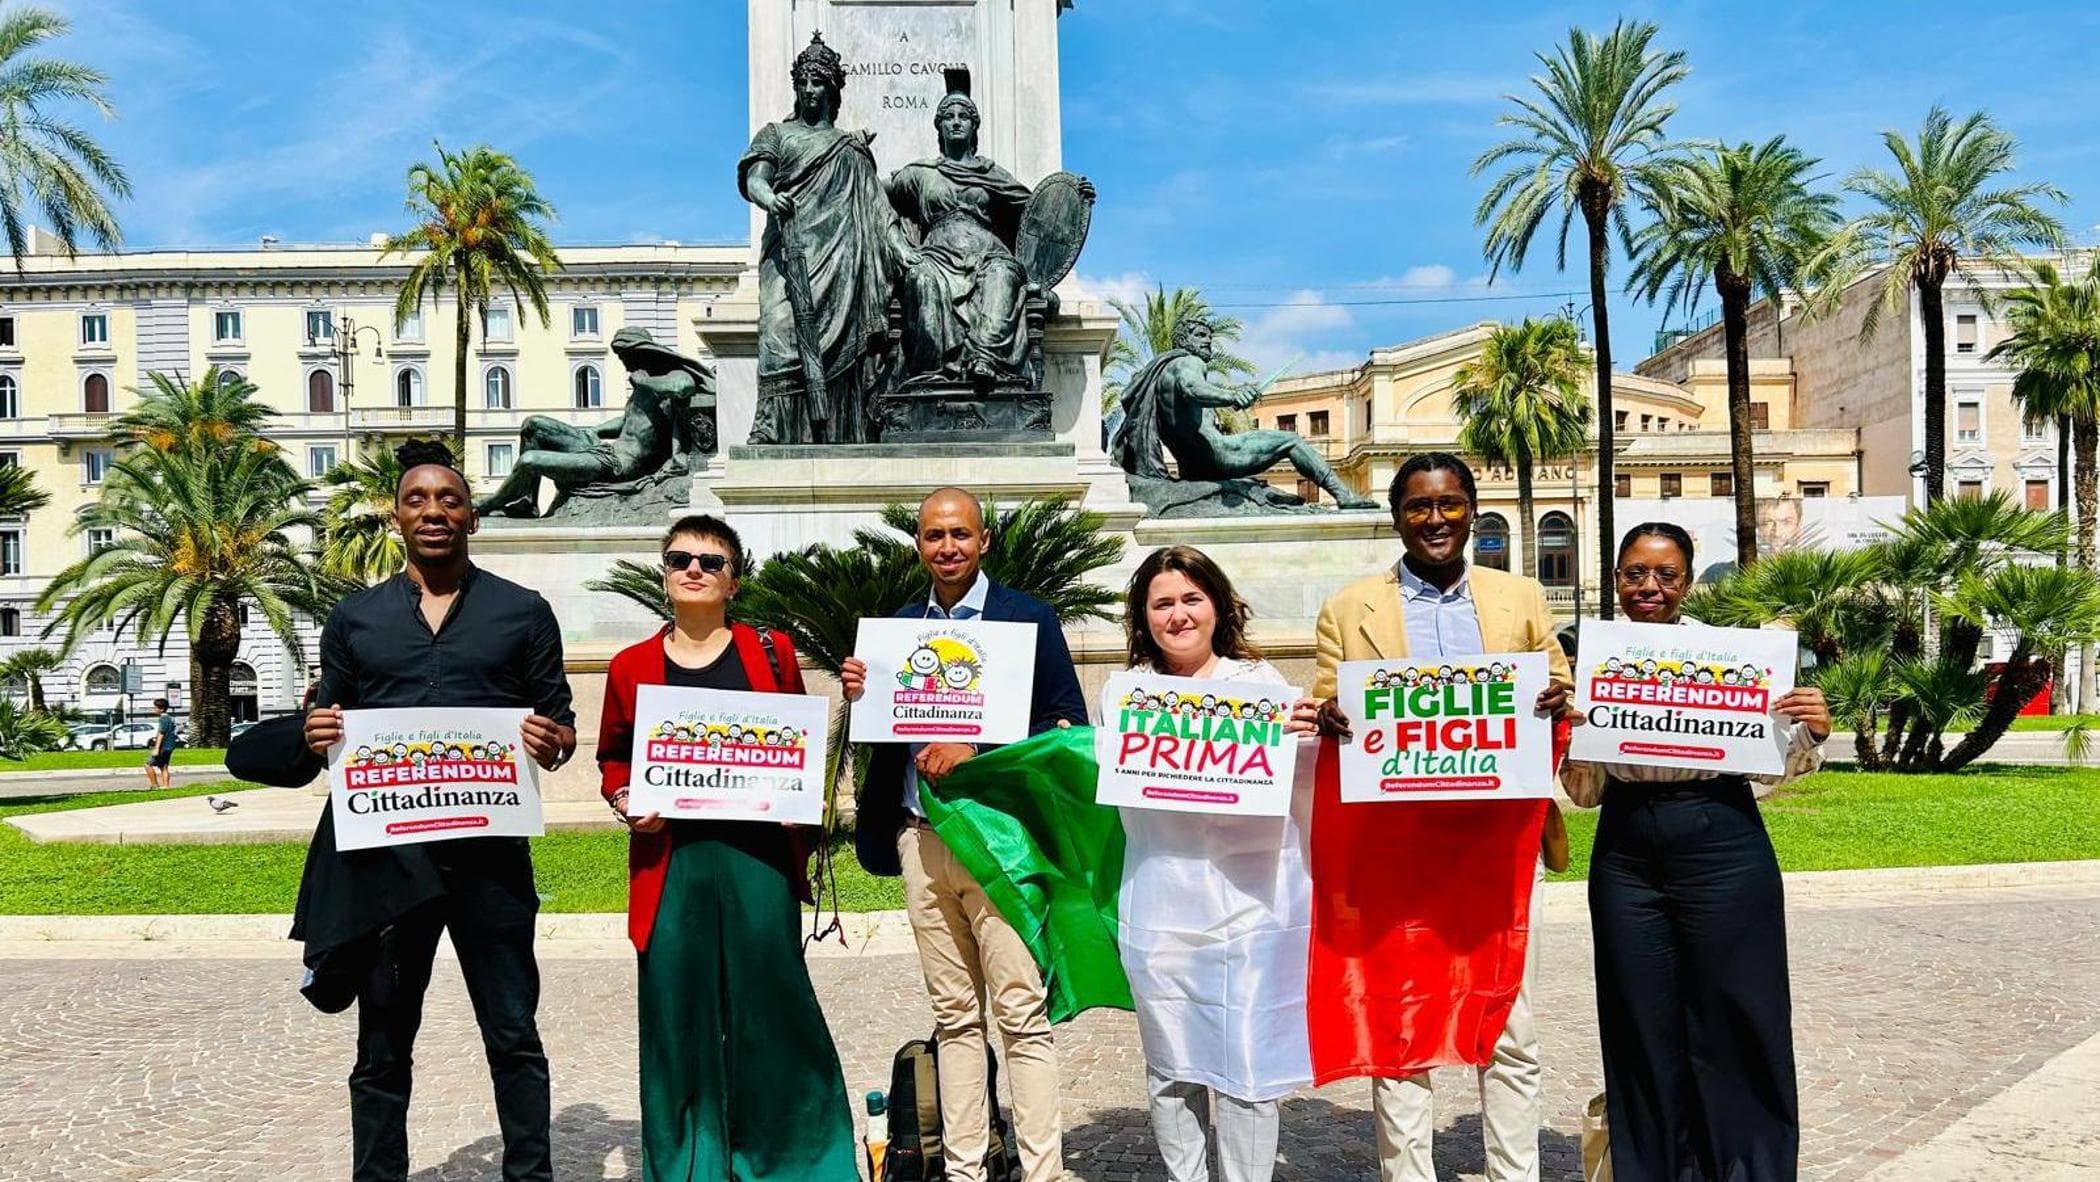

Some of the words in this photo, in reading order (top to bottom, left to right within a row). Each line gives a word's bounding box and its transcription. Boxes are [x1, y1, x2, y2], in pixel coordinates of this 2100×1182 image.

[899, 32, 909, 42] A
[841, 62, 902, 75] CAMILLO
[883, 96, 928, 109] ROMA
[1625, 646, 1655, 659] Figlie
[1671, 648, 1692, 661] figli
[1696, 649, 1738, 662] d'Italia
[895, 693, 981, 704] REFERENDUM
[1365, 682, 1515, 719] FIGLIE
[1595, 681, 1763, 708] REFERENDUM
[679, 711, 705, 723] Figlie
[719, 711, 738, 725] figli
[742, 713, 778, 724] d'Italia
[893, 705, 983, 719] Cittadinanza
[1588, 705, 1765, 739] Cittadinanza
[374, 732, 402, 745] Figlie
[408, 733, 415, 741] e
[419, 730, 439, 742] figli
[444, 730, 482, 741] d'Italia
[1119, 709, 1281, 746] ITALIANI
[1364, 729, 1384, 754] e
[1396, 717, 1516, 752] FIGLI
[651, 744, 800, 765] REFERENDUM
[1118, 732, 1274, 777] PRIMA
[1382, 746, 1498, 776] d'Italia
[351, 764, 511, 785] REFERENDUM
[1158, 772, 1202, 781] RICHIEDERE
[1217, 777, 1274, 786] CITTADINANZA
[348, 786, 521, 815] Cittadinanza
